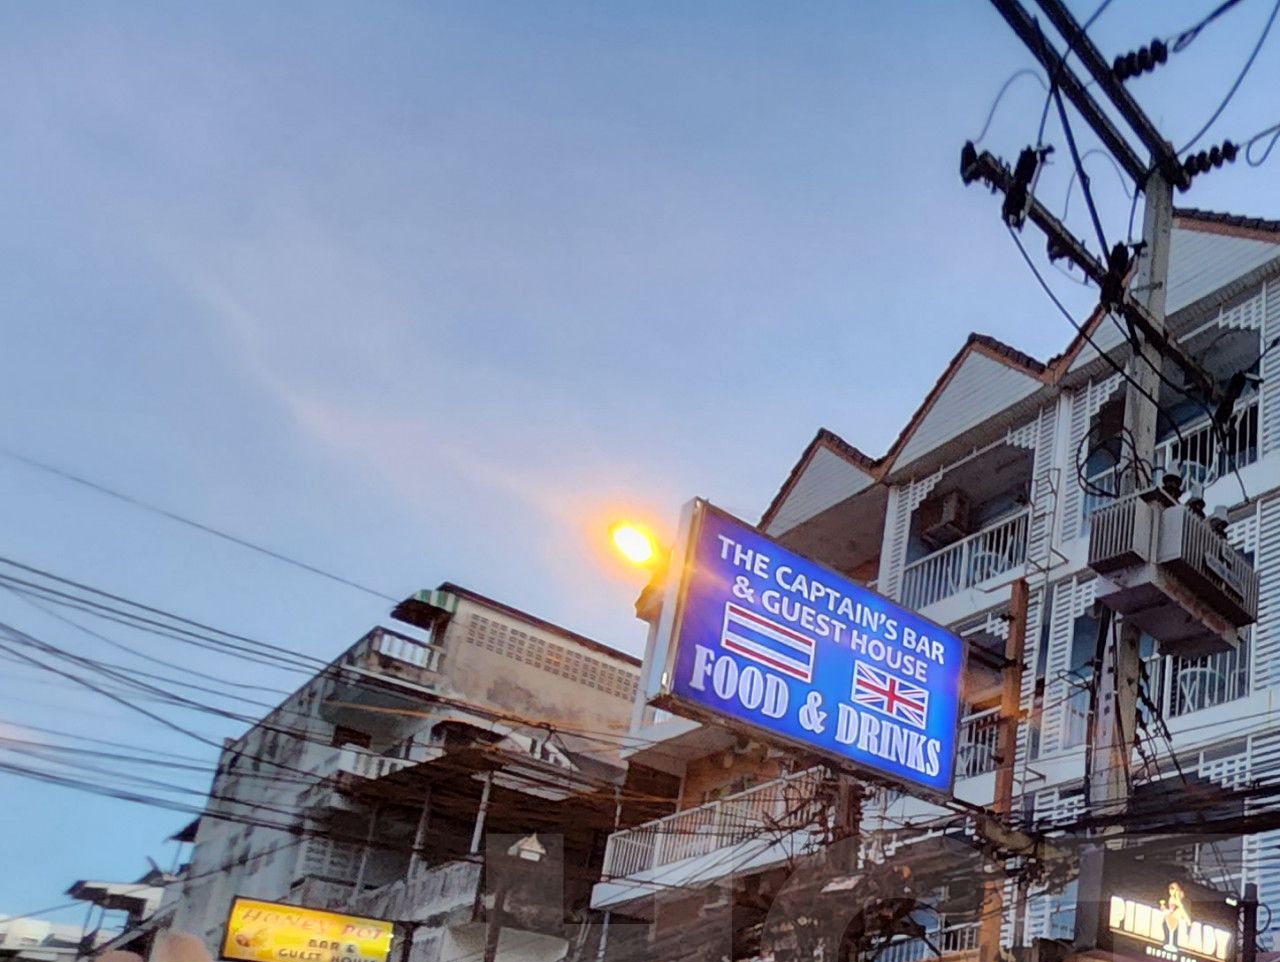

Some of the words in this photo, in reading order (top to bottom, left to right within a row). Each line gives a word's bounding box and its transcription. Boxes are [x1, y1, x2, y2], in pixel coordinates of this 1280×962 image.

[718, 535, 770, 579] THE
[775, 565, 898, 641] CAPTAIN'S
[902, 629, 945, 664] BAR
[732, 575, 755, 604] &
[762, 589, 847, 643] GUEST
[851, 629, 928, 683] HOUSE
[689, 644, 789, 719] FOOD
[799, 691, 827, 734] &
[834, 702, 942, 777] DRINKS
[278, 948, 322, 961] GUEST
[308, 939, 340, 950] BAR
[342, 924, 384, 940] POT
[1109, 895, 1166, 942] PINK
[1177, 915, 1231, 960] LADY
